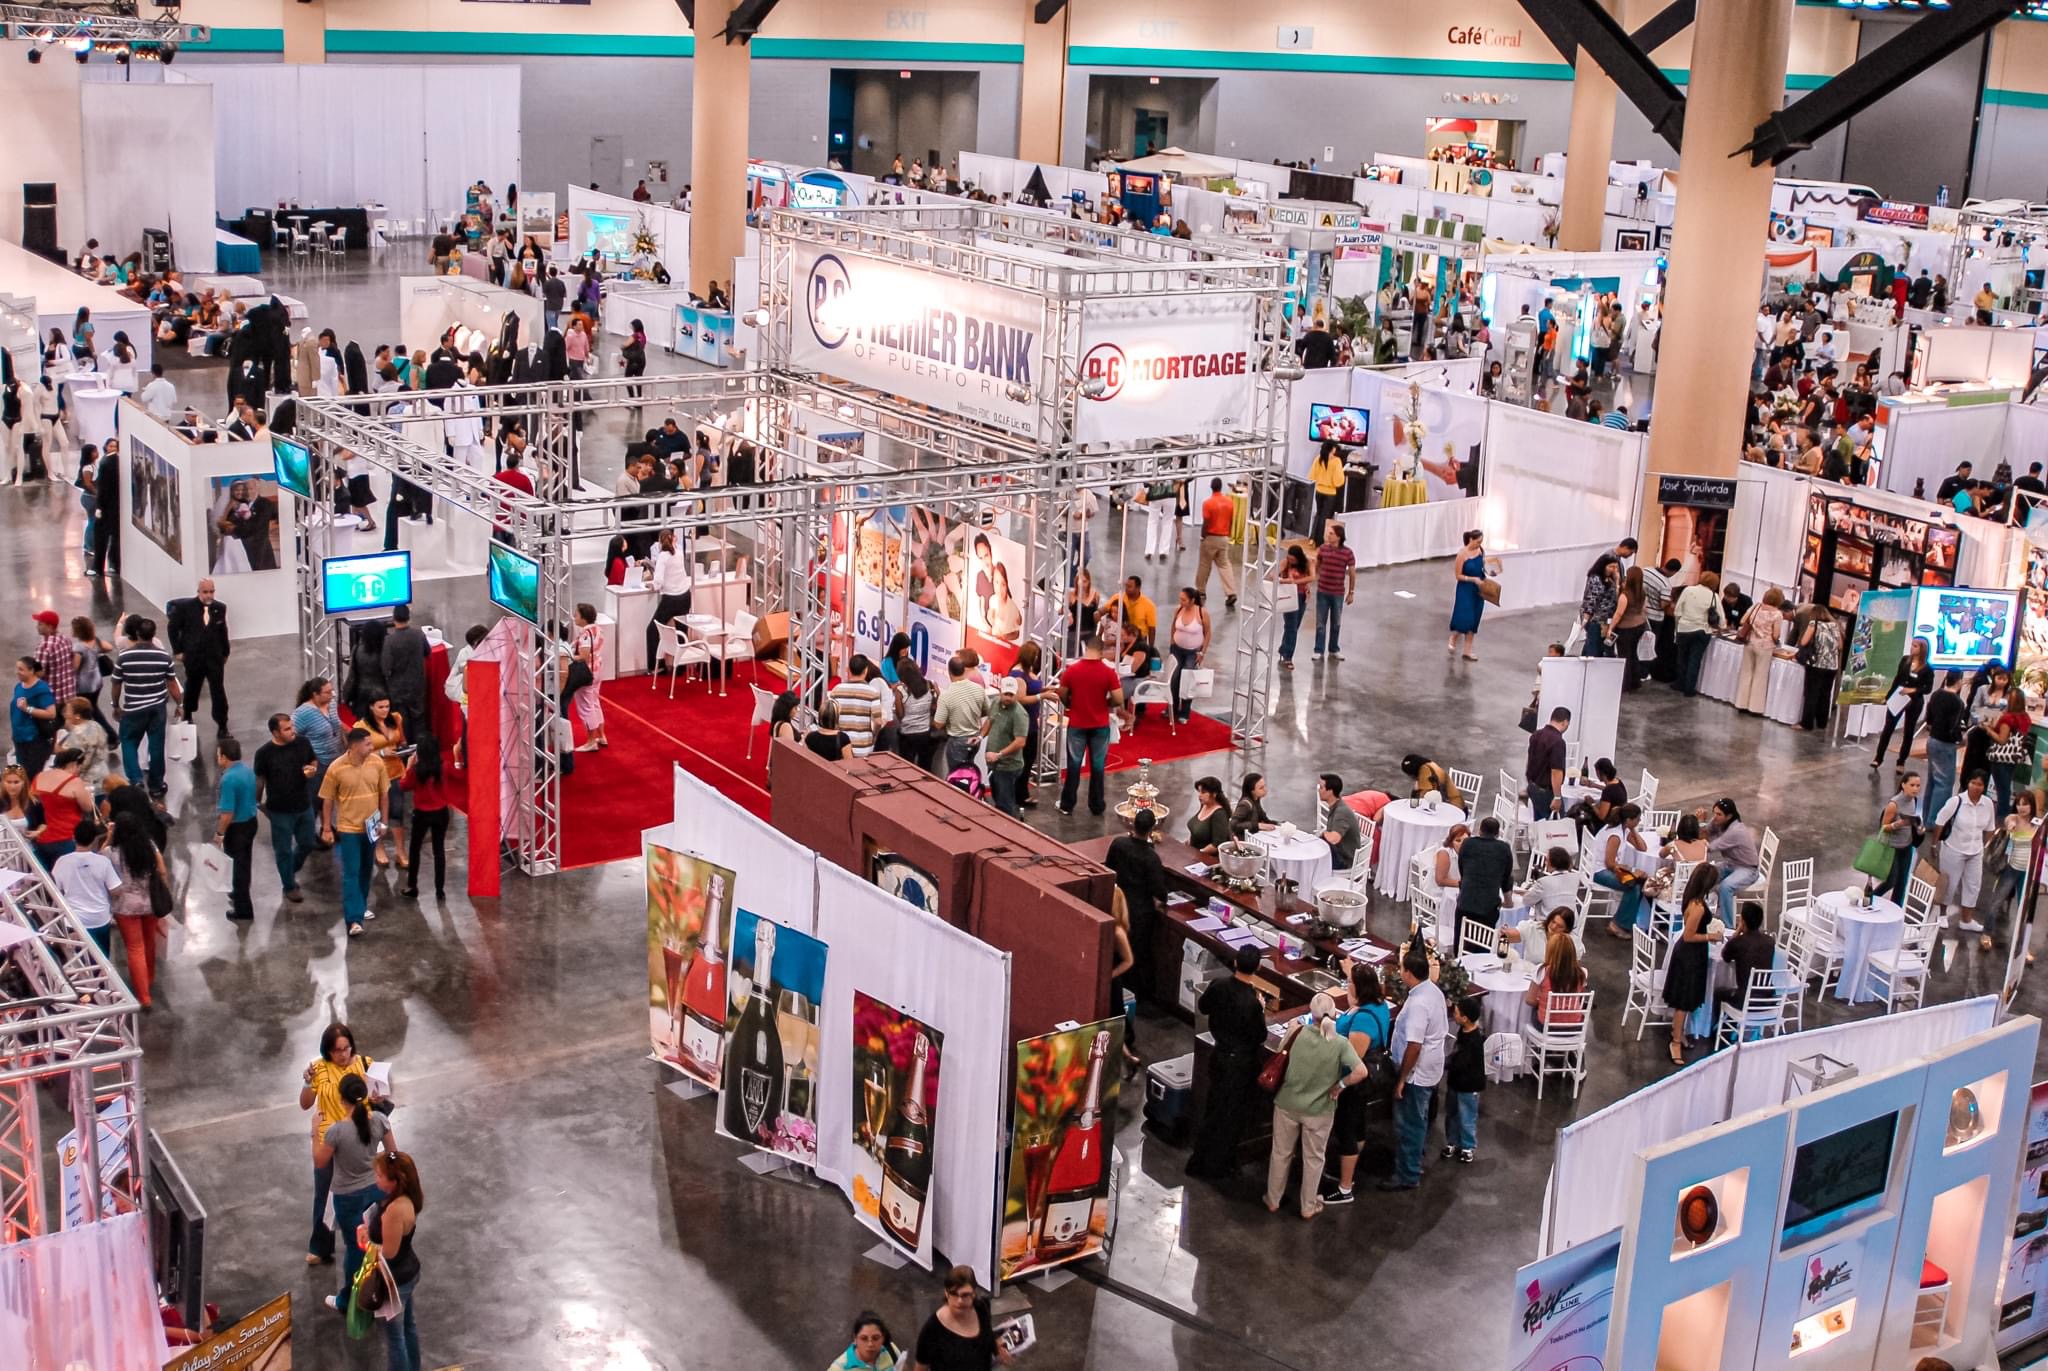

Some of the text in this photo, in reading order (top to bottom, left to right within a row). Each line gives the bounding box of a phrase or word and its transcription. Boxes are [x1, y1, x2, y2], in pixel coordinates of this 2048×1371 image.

[885, 10, 929, 31] EXIT
[1138, 19, 1178, 40] EXIT
[1447, 26, 1522, 48] Café Coral
[1881, 201, 1915, 213] GRUPO
[1322, 214, 1333, 226] A
[1334, 214, 1359, 228] MED
[1360, 234, 1381, 243] STAR
[855, 298, 958, 367] EMIER
[963, 316, 1034, 386] BANK
[854, 343, 876, 361] OF
[888, 352, 967, 388] PUERTO
[1132, 351, 1247, 382] MORTGAGE
[1660, 479, 1729, 496] José Sepúlveda
[1560, 1296, 1580, 1310] LINE
[175, 1355, 212, 1371] liday
[212, 1340, 237, 1361] Inn
[238, 1327, 258, 1344] San
[259, 1310, 284, 1333] Juan
[226, 1347, 251, 1365] PUERTO
